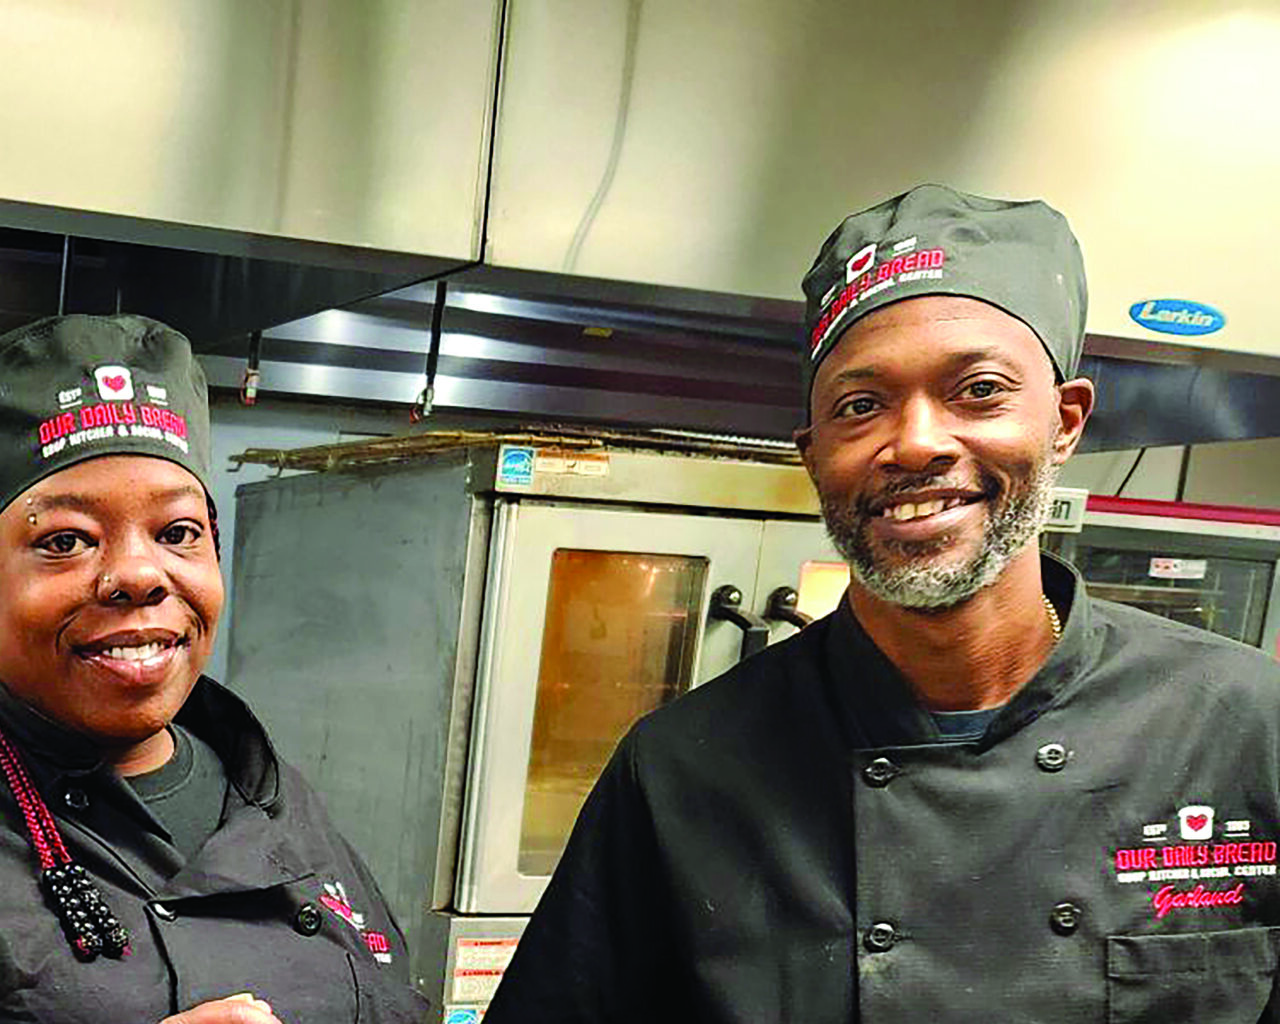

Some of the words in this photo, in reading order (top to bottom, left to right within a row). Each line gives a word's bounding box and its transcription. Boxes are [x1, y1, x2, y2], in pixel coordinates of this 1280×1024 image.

[877, 249, 944, 281] BREAD
[39, 412, 76, 444] OUR
[79, 402, 136, 429] DAILY
[1116, 848, 1157, 870] OUR
[1162, 844, 1209, 867] DAILY
[1213, 841, 1277, 865] BREAD
[1153, 882, 1245, 918] Garland
